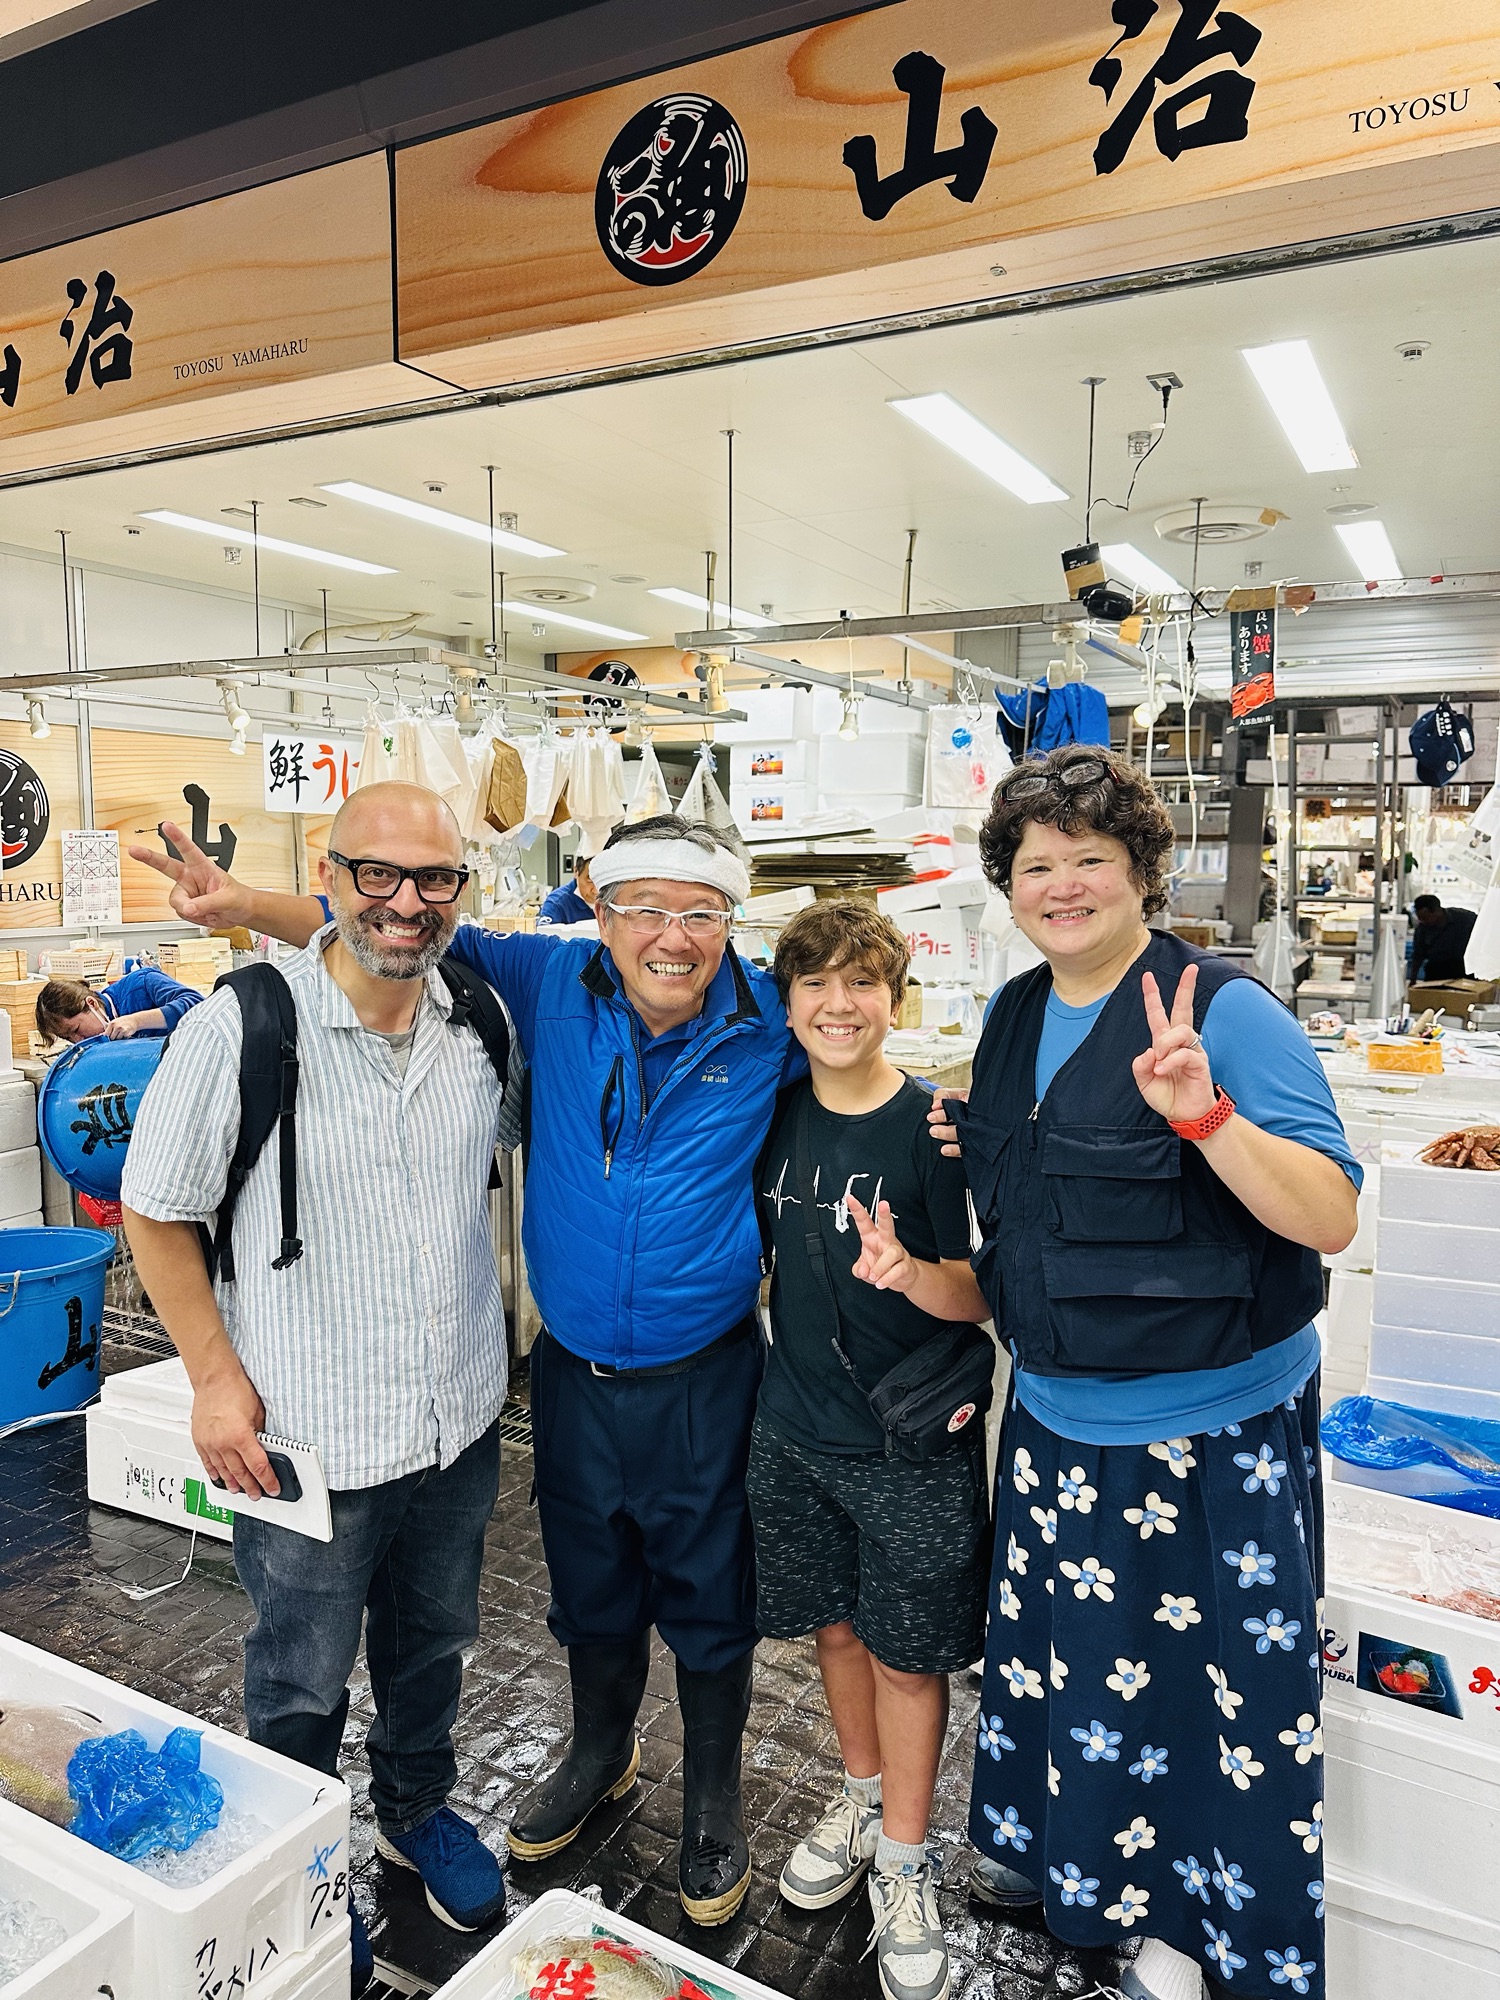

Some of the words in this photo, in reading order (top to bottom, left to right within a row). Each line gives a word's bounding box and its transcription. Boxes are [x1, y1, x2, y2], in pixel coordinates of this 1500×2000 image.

[1348, 87, 1471, 134] TOYOSU
[174, 356, 224, 380] TOYOSU
[232, 338, 310, 368] YAMAHARU
[1238, 626, 1253, 677] あります。
[37, 1295, 98, 1392] 山
